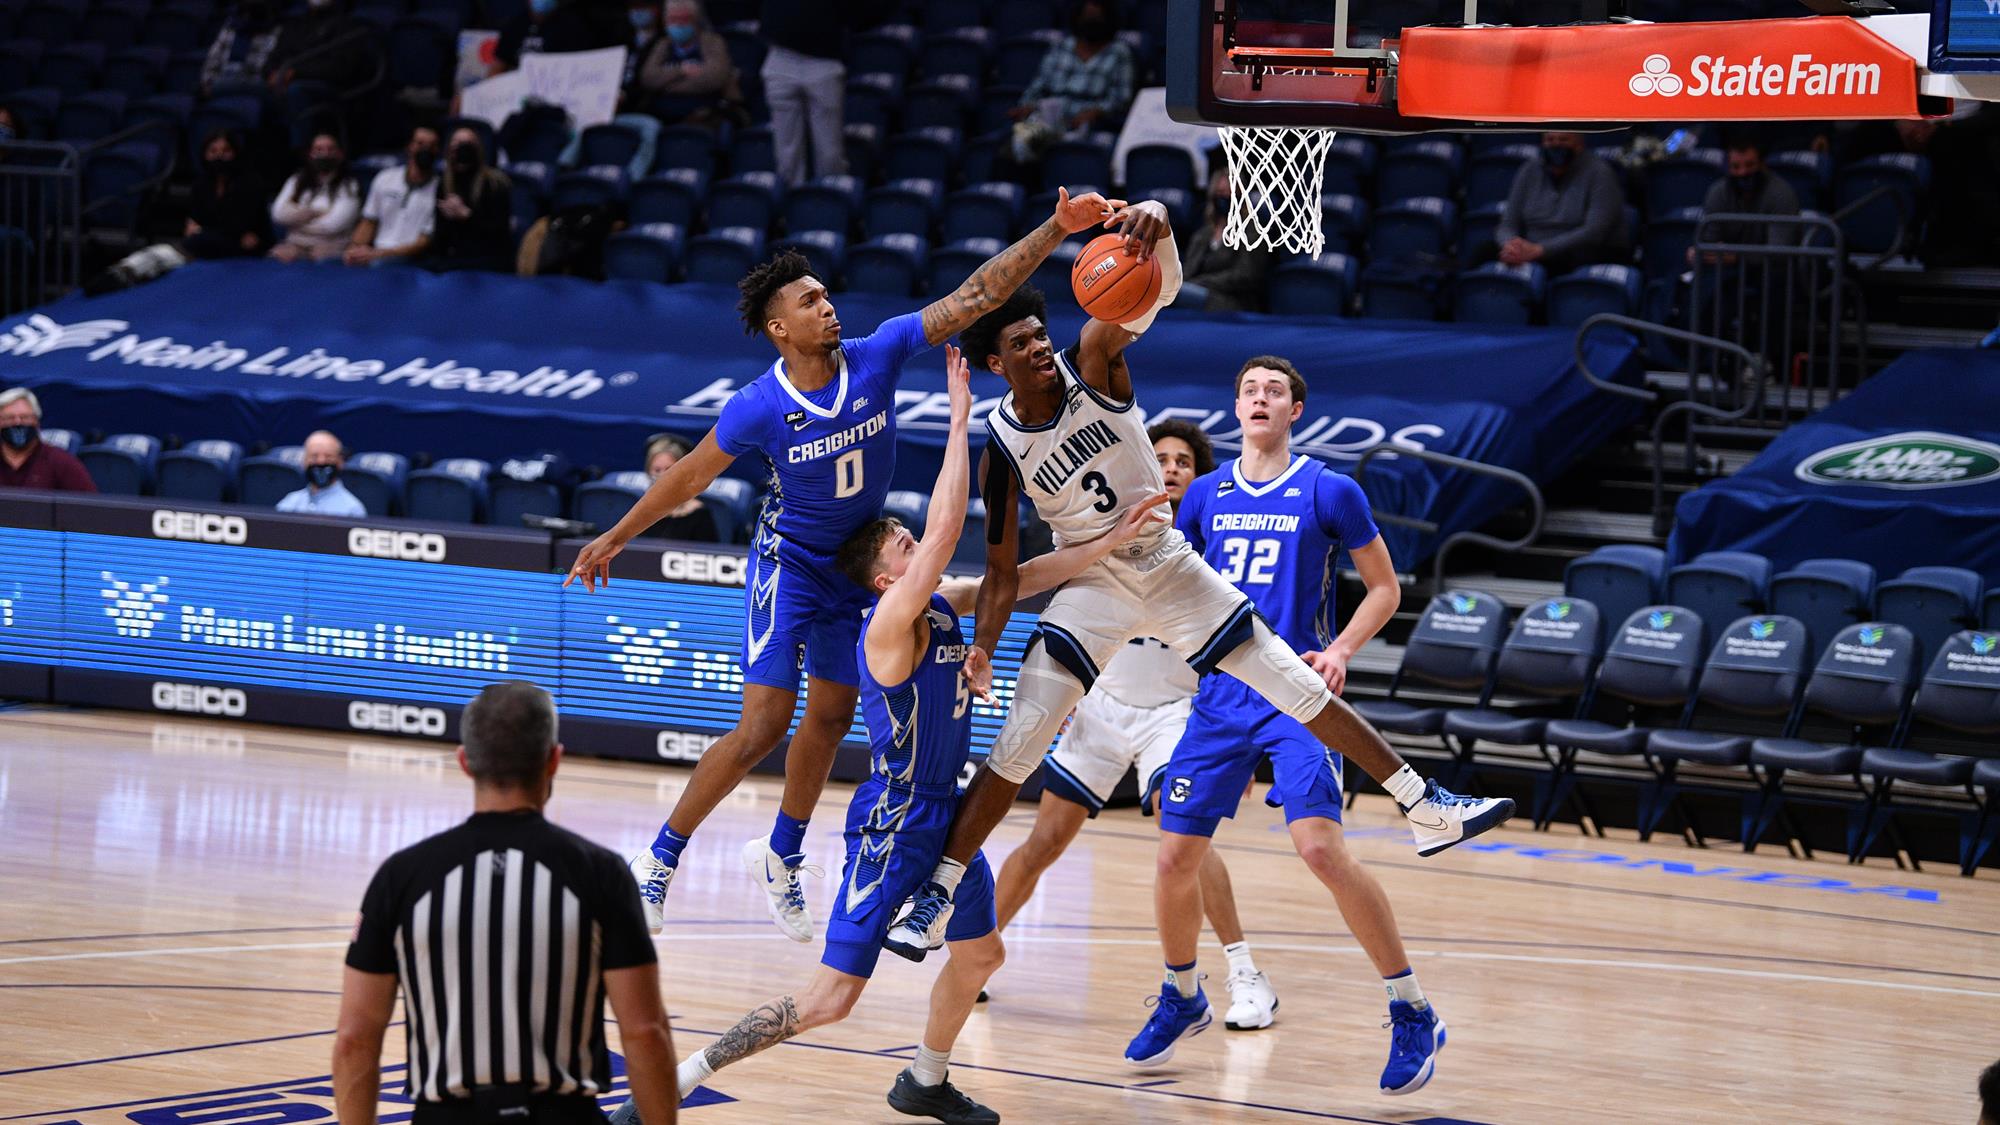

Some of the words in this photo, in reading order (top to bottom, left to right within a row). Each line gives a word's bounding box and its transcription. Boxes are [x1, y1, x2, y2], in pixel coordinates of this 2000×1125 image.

[87, 333, 248, 371] Main
[240, 346, 385, 382] Line
[377, 357, 605, 399] Health
[788, 410, 887, 463] CREIGHTON
[1032, 419, 1122, 496] VILLANOVA
[834, 448, 864, 499] 0
[1081, 471, 1117, 513] 3
[152, 509, 248, 545] GEICO
[1212, 513, 1300, 532] CREIGHTON
[348, 527, 446, 562] GEICO
[1220, 537, 1281, 584] 32
[152, 681, 248, 717] GEICO
[952, 671, 969, 720] 5
[348, 700, 446, 736] GEICO
[657, 730, 720, 761] GEI
